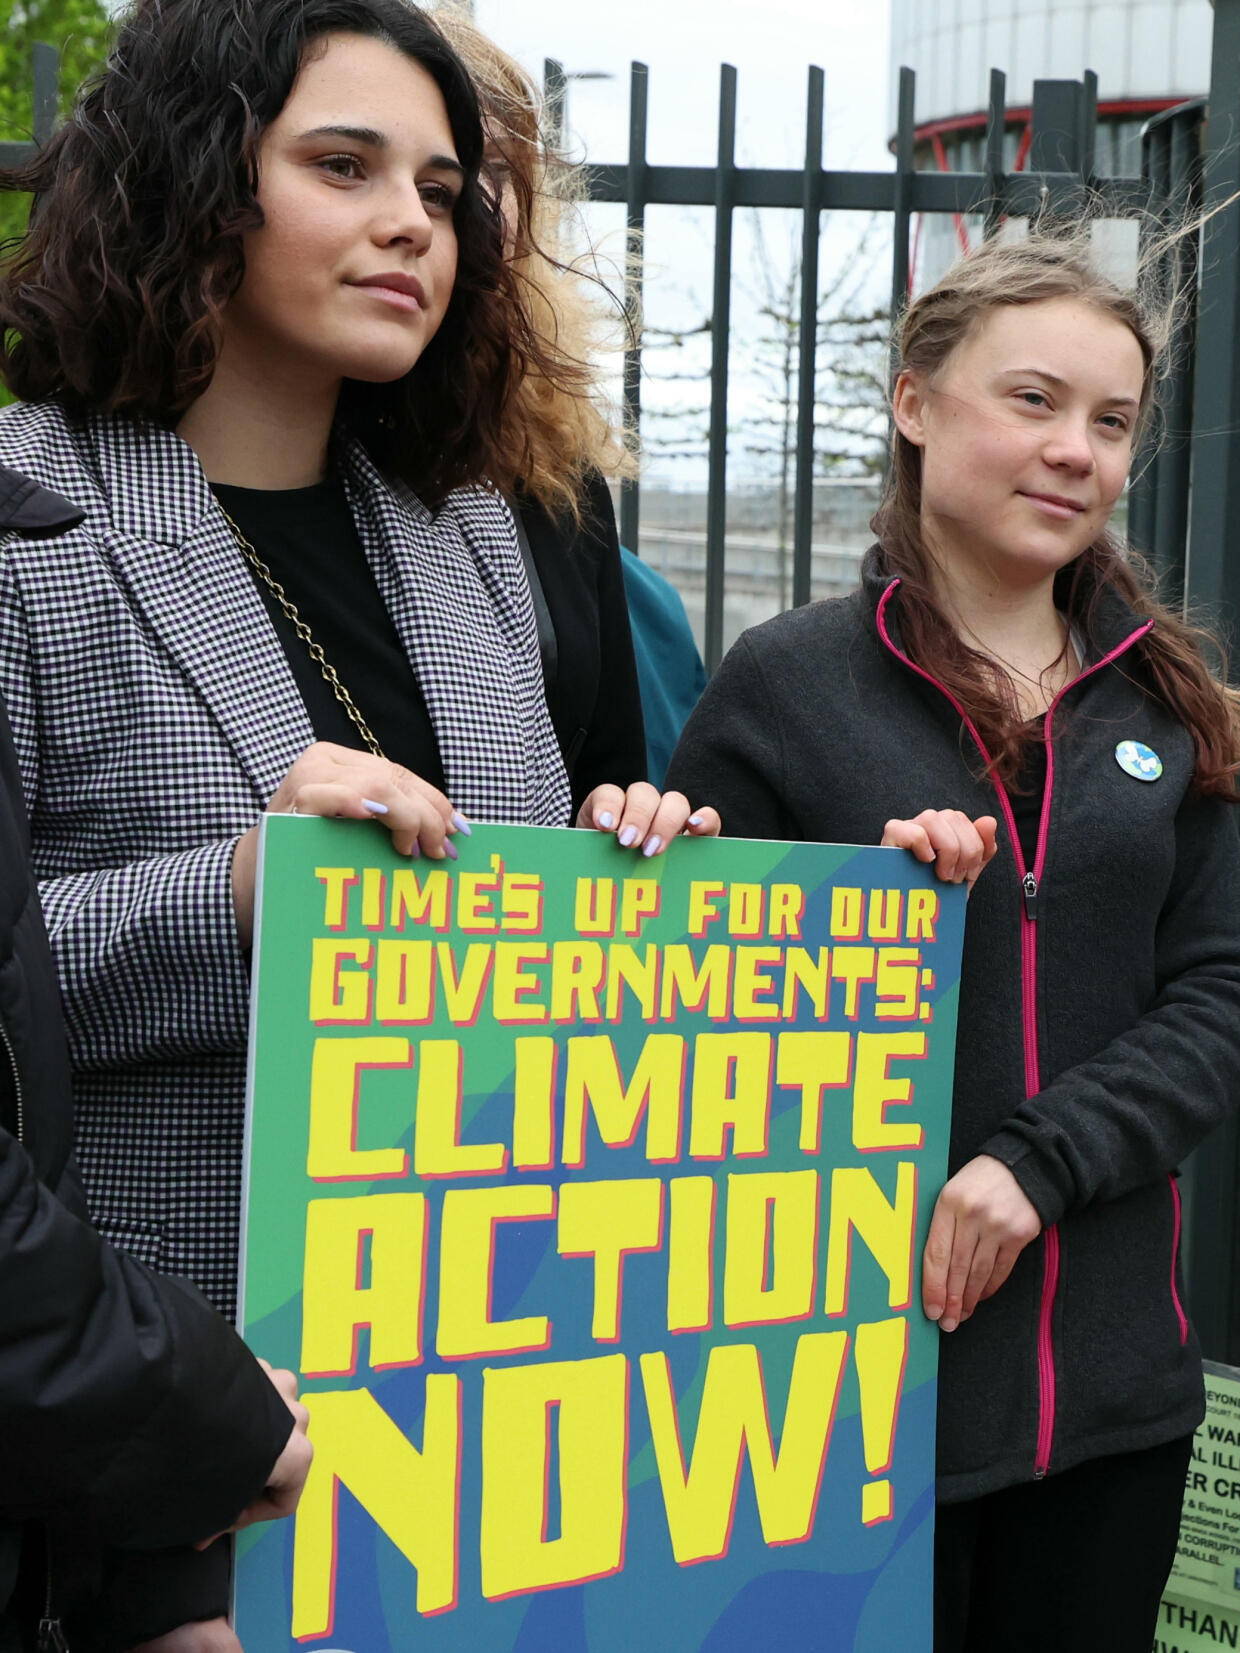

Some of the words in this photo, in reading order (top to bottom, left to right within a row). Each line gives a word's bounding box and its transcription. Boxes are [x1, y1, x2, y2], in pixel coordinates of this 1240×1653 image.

[315, 853, 545, 934] TIME'S
[575, 878, 660, 936] UP
[688, 881, 803, 938] FOR
[831, 887, 938, 942] OUR
[309, 938, 934, 1024] GOVERNMENTS:
[307, 1031, 926, 1181] CLIMATE
[300, 1162, 917, 1376] ACTION
[291, 1317, 907, 1640] NOW!
[1198, 1502, 1223, 1515] Even
[1222, 1522, 1240, 1533] For
[1161, 1601, 1238, 1648] THAN
